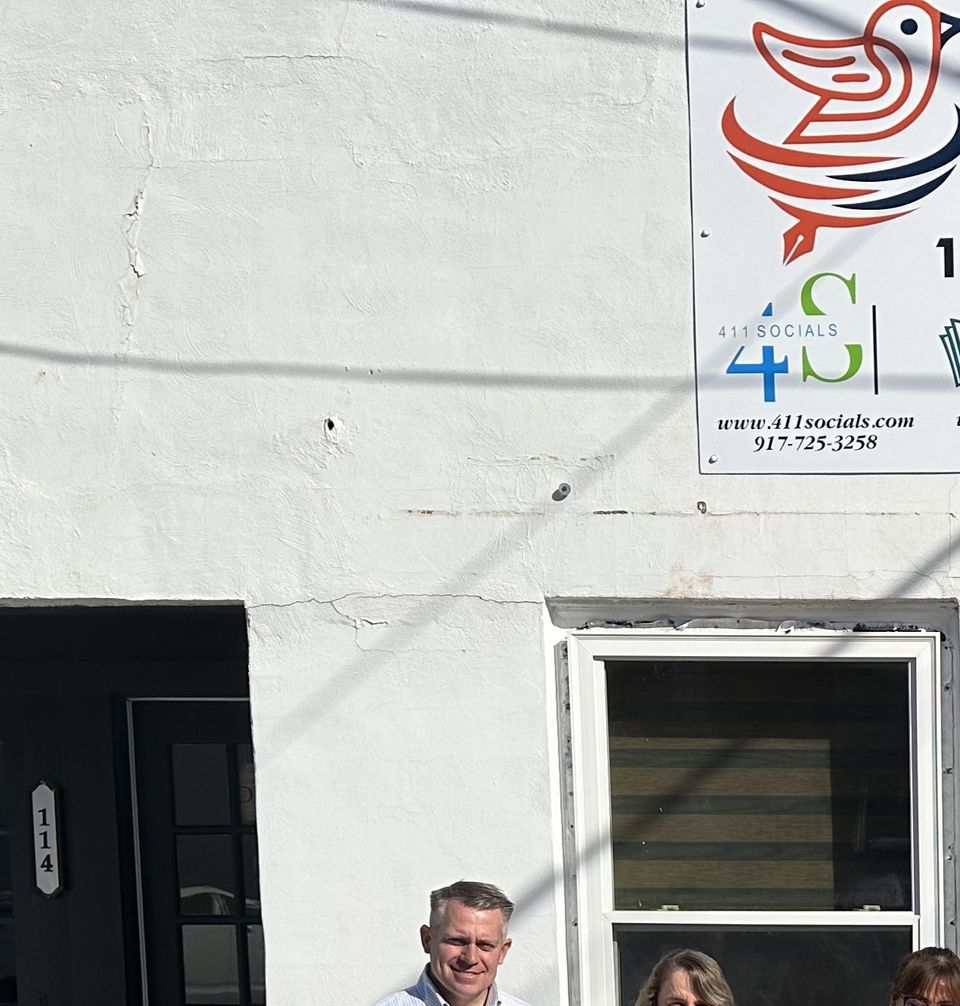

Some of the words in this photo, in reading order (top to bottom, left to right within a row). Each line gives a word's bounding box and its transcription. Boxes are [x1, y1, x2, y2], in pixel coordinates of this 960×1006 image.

[718, 325, 748, 338] 411
[757, 323, 838, 337] SOCIALS
[717, 413, 915, 431] www.411socials.com
[753, 434, 878, 452] 917-725-3258
[38, 808, 54, 872] 114
